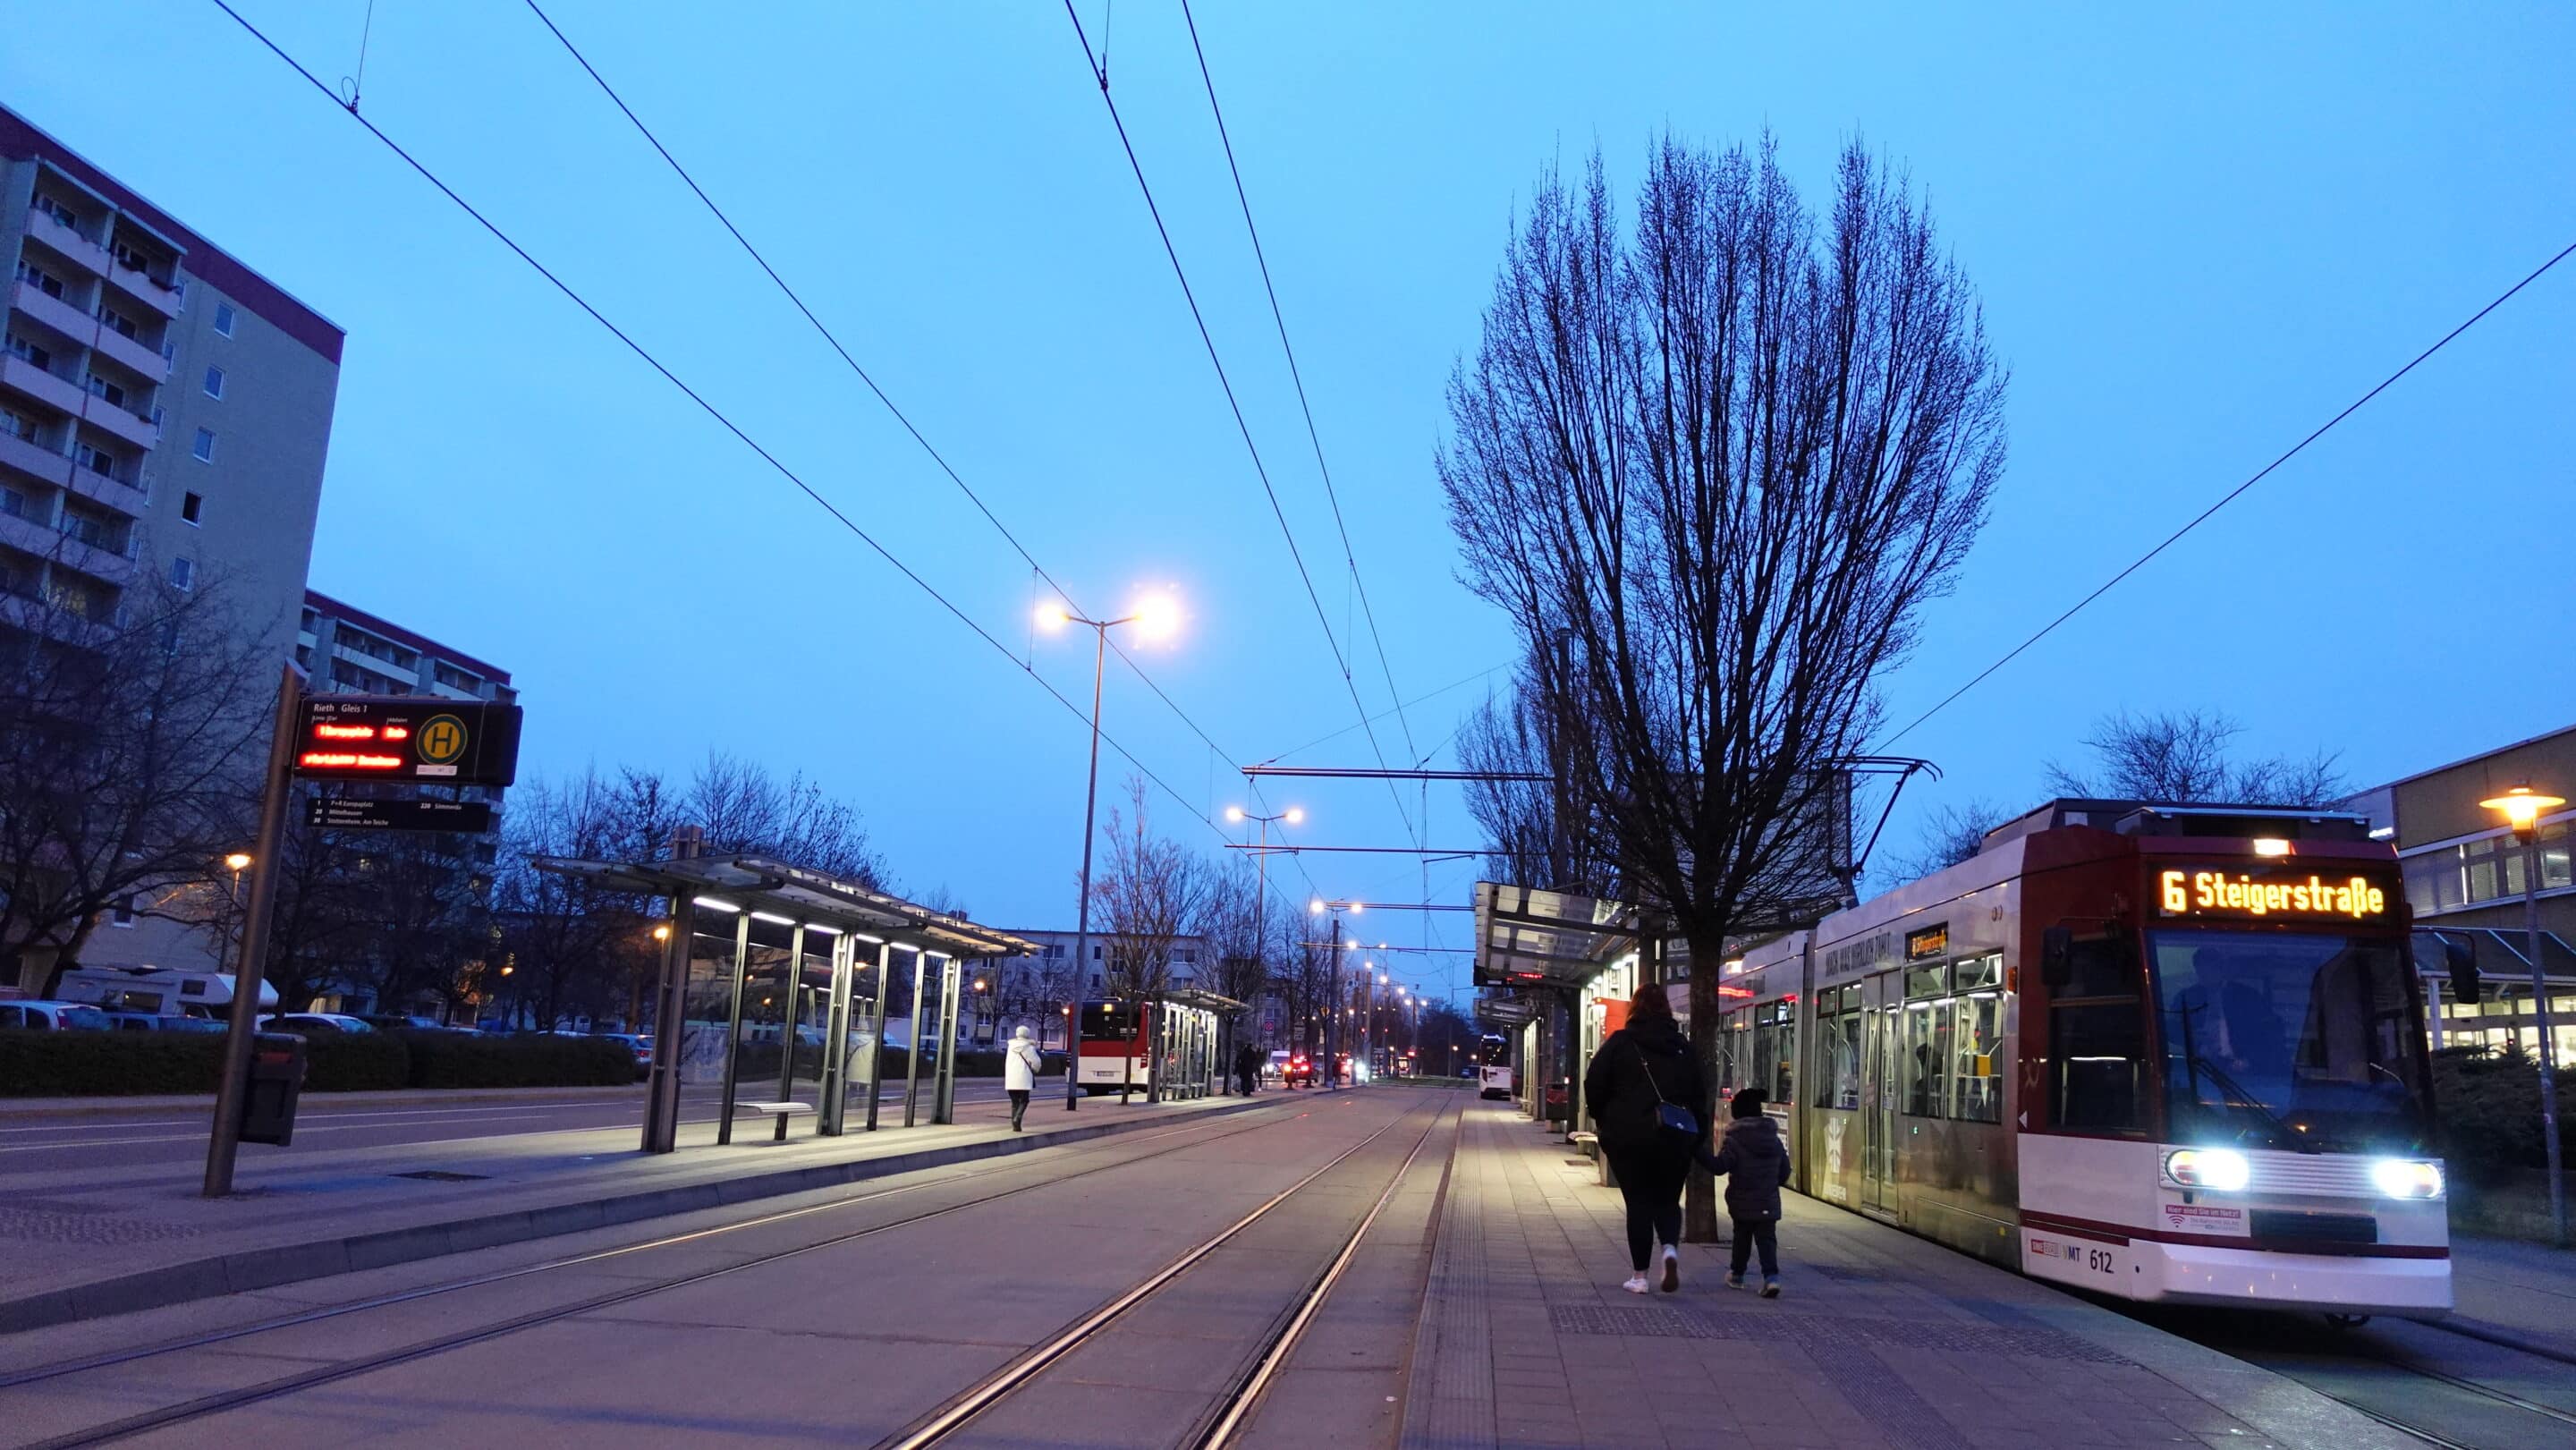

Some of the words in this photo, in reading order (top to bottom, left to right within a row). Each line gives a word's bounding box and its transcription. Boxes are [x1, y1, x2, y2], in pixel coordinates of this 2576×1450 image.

[314, 703, 335, 713] Rieth
[341, 704, 361, 713] Gleis
[363, 704, 369, 713] 1
[2162, 870, 2187, 912] 6
[2195, 871, 2385, 919] Steigerstraße
[2089, 1249, 2114, 1274] 612
